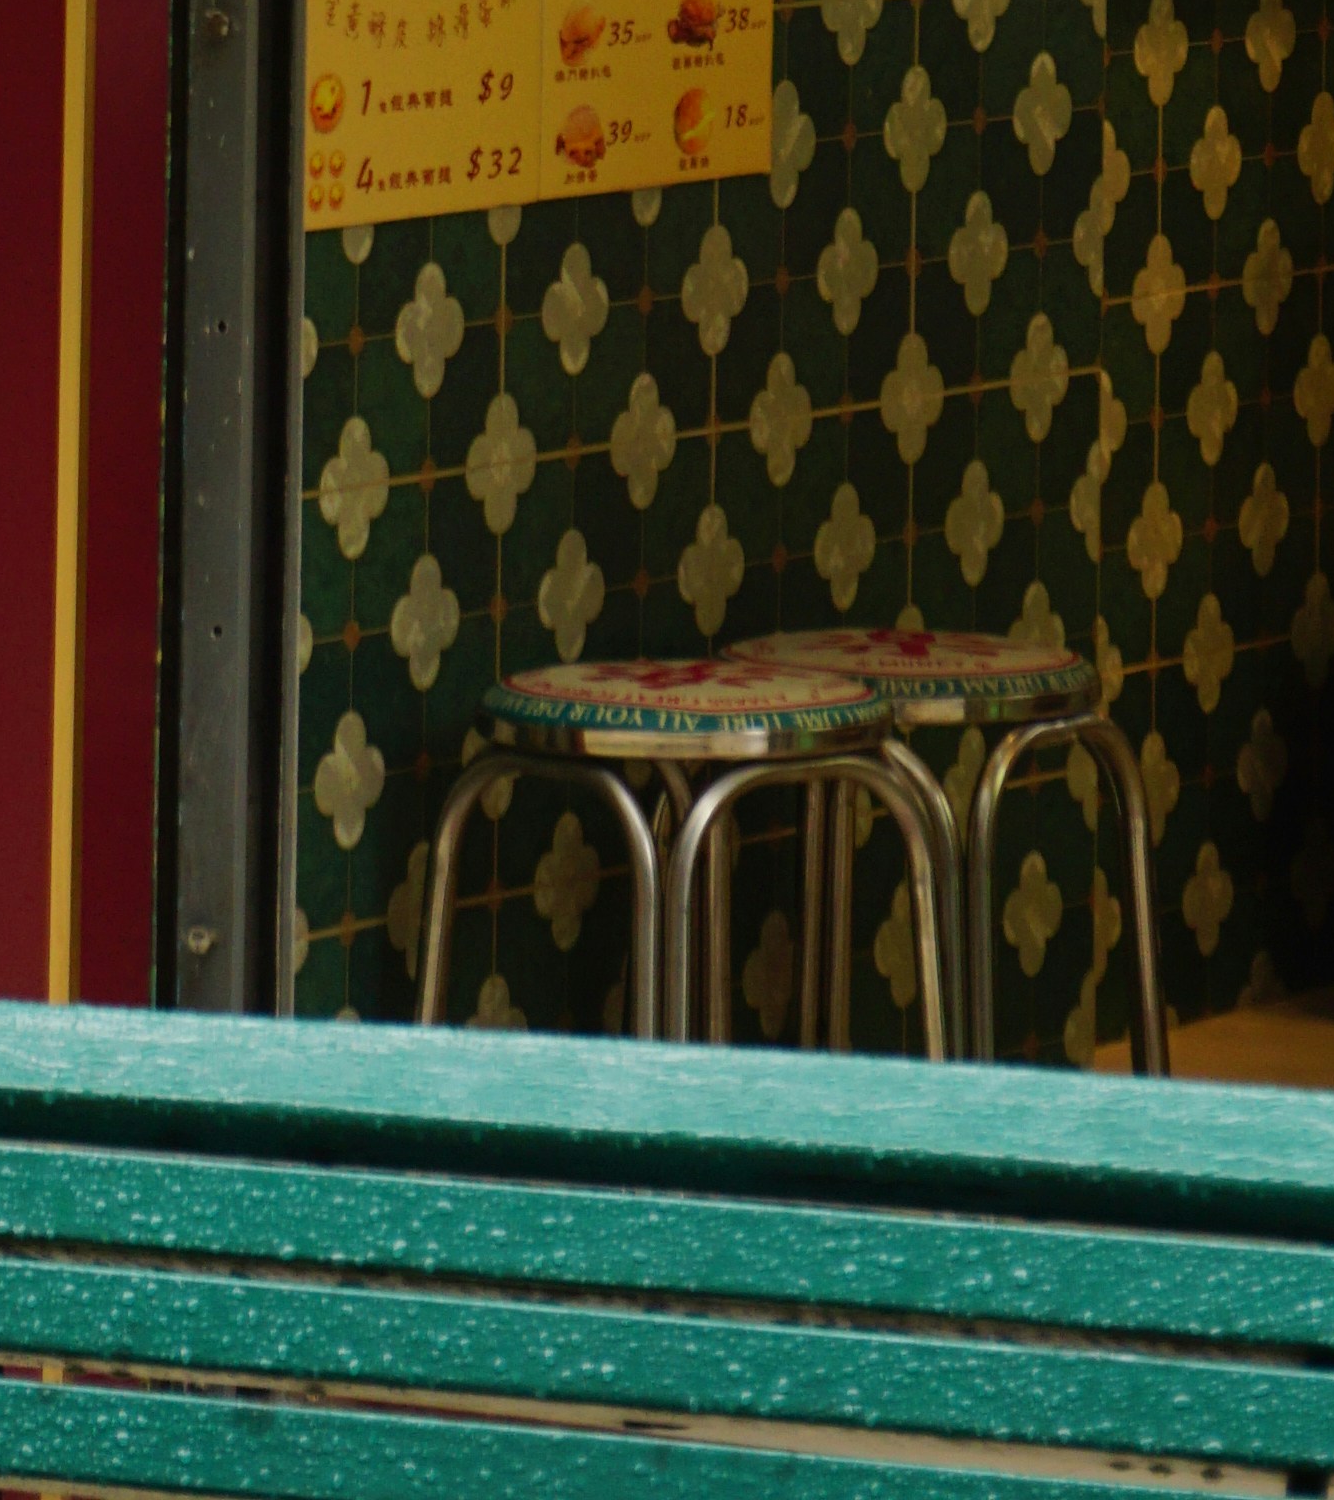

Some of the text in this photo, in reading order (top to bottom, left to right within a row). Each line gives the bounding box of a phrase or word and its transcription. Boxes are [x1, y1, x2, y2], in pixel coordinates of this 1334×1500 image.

[607, 20, 636, 48] 35
[725, 6, 751, 34] 38
[725, 103, 748, 129] 18
[607, 119, 634, 148] 39
[466, 145, 524, 182] $32
